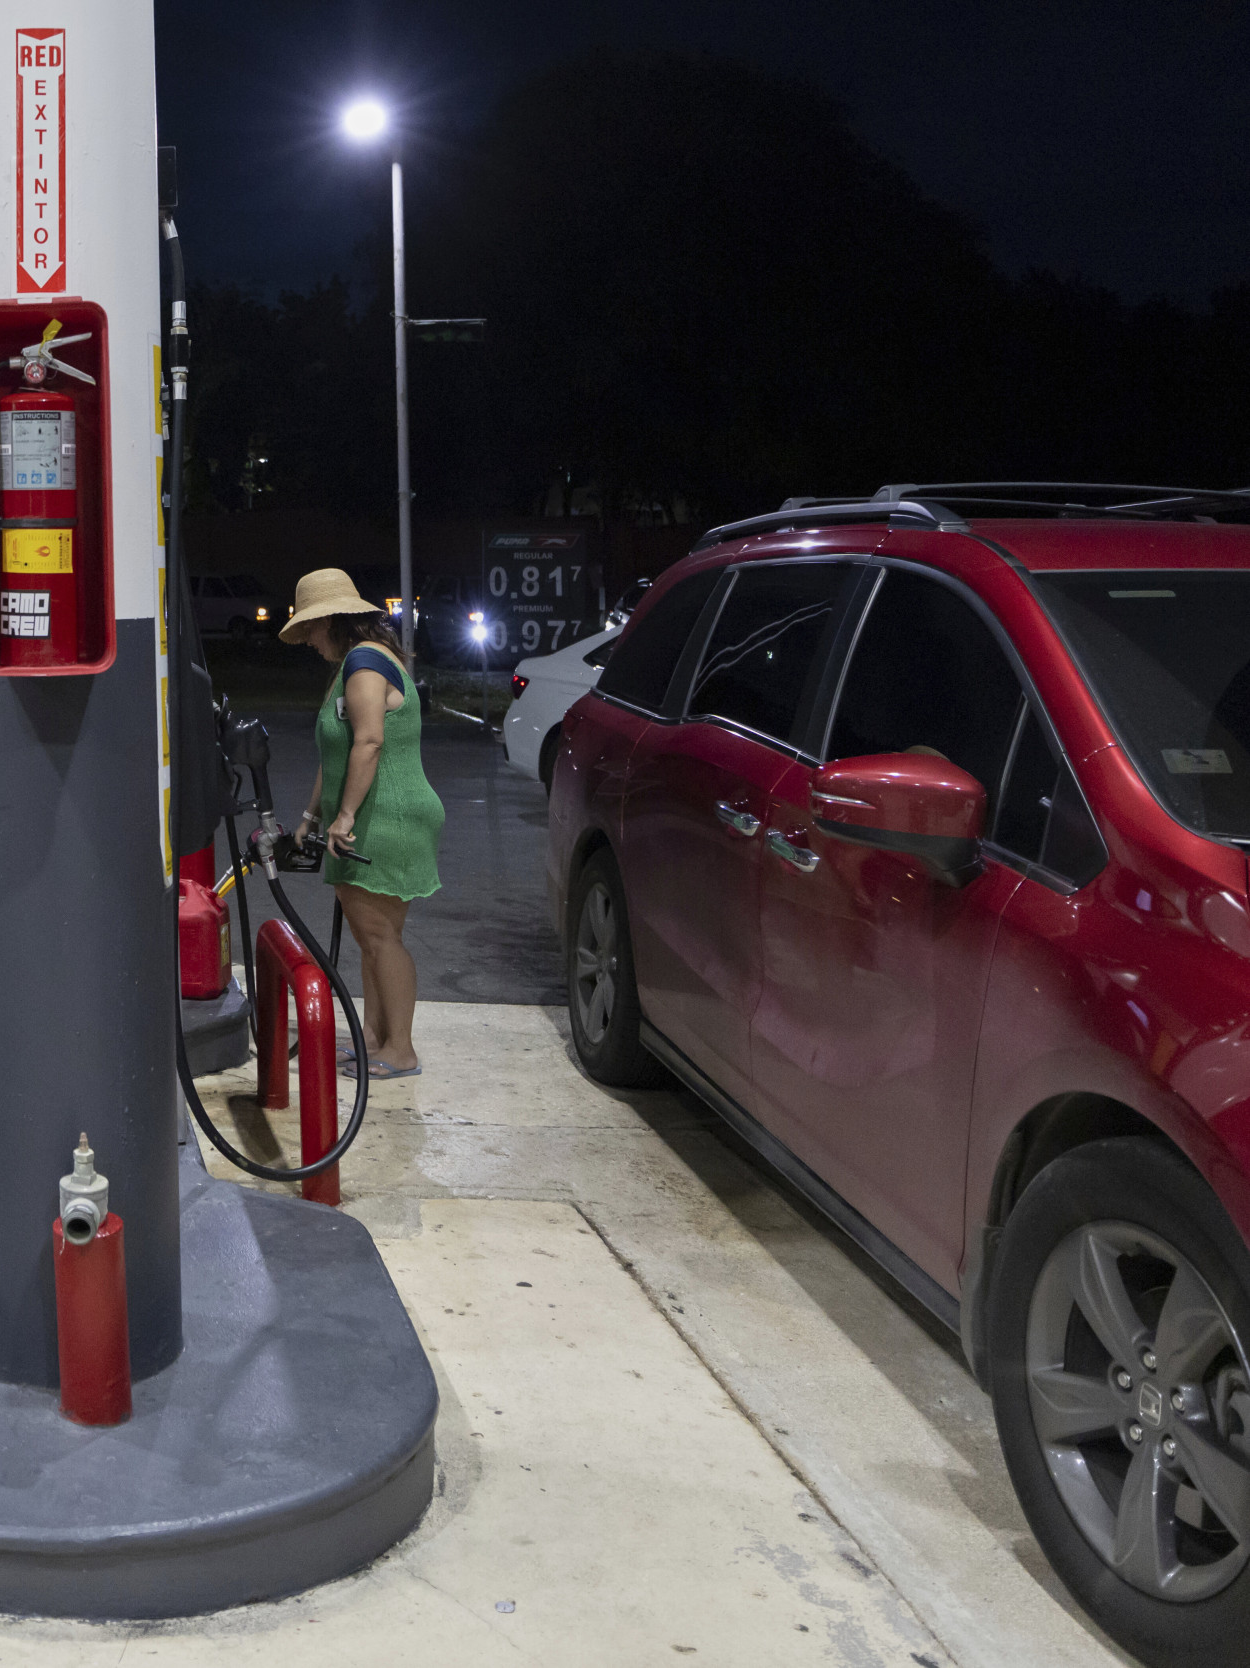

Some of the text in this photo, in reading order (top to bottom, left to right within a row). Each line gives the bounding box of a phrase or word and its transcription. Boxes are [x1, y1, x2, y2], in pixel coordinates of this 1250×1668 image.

[20, 46, 61, 67] RED
[33, 80, 49, 269] EXTINTOR
[14, 412, 59, 420] INSTRUCTIONS
[513, 552, 554, 560] REGULAR
[1, 592, 50, 614] CAMO
[513, 605, 554, 613] PREMIUM
[1, 615, 50, 637] CREW
